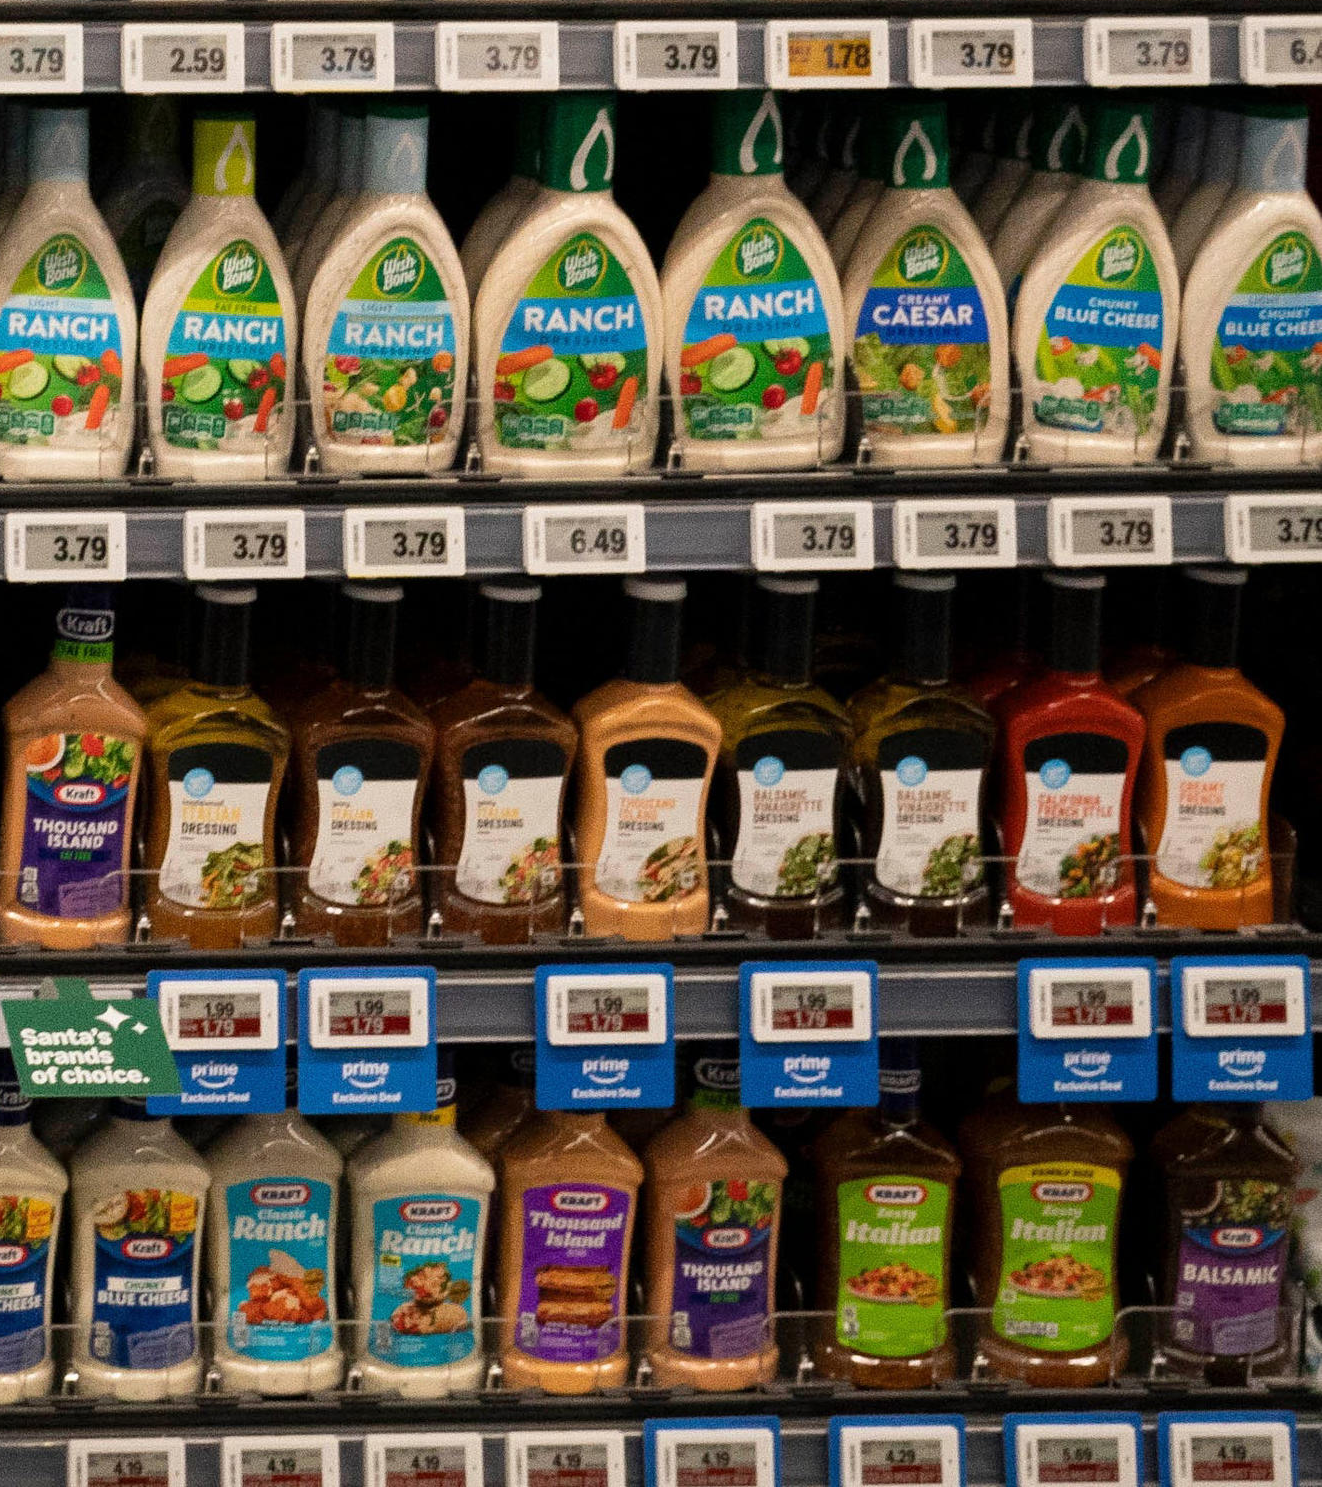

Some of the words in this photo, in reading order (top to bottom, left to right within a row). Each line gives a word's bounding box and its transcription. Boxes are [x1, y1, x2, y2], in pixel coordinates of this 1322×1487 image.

[9, 49, 63, 72] 3.79
[171, 48, 225, 72] 2.59
[485, 47, 539, 71] 3.79
[961, 42, 1013, 68] 3.79
[704, 289, 815, 320] RANCH
[898, 293, 950, 305] CREAMY
[873, 305, 973, 326] CAESAR
[1055, 306, 1098, 326] BLUE
[1102, 312, 1159, 329] CHEESE
[9, 314, 109, 342] RANCH
[345, 322, 443, 347] RANCH
[393, 531, 446, 556] 3.79
[571, 528, 626, 554] 6.49
[945, 523, 997, 549] 3.79
[53, 537, 106, 562] 3.79
[64, 786, 95, 801] Kraft
[33, 818, 117, 835] THOUSAND
[47, 833, 103, 850] ISLAND
[205, 1003, 235, 1018] 1.99
[592, 997, 622, 1012] 1.99
[21, 1029, 112, 1046] Santa's
[27, 1048, 113, 1065] brands
[32, 1067, 57, 1084] of
[62, 1067, 150, 1085] choice.
[846, 1221, 941, 1245] Italian
[1011, 1219, 1107, 1243] Italian
[682, 1262, 762, 1278] THOUSAND
[1184, 1264, 1278, 1286] BALSAMIC
[698, 1276, 750, 1292] ISLAND
[114, 1461, 142, 1475] 4.19
